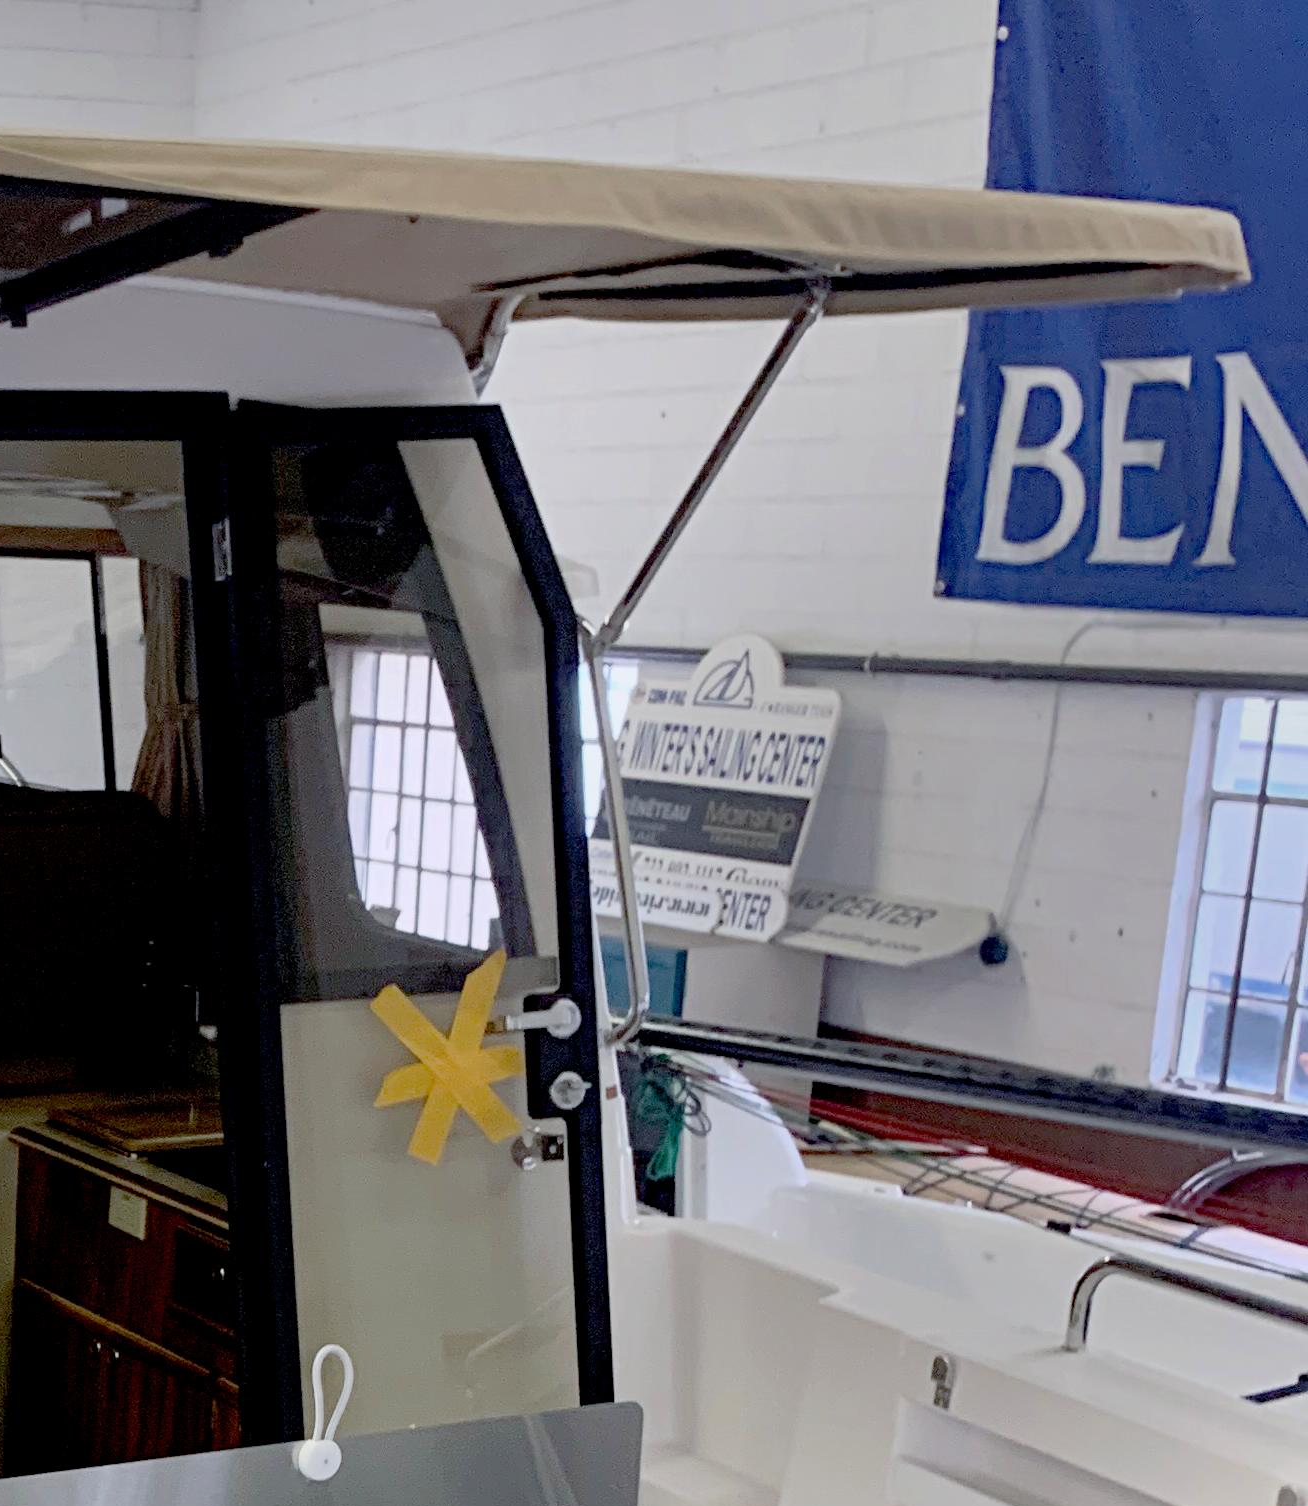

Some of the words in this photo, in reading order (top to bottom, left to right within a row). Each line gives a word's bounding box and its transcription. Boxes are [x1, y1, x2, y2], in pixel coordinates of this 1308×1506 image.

[697, 725, 762, 782] SAILING
[758, 730, 826, 788] CENTER
[717, 888, 772, 931] ENTER
